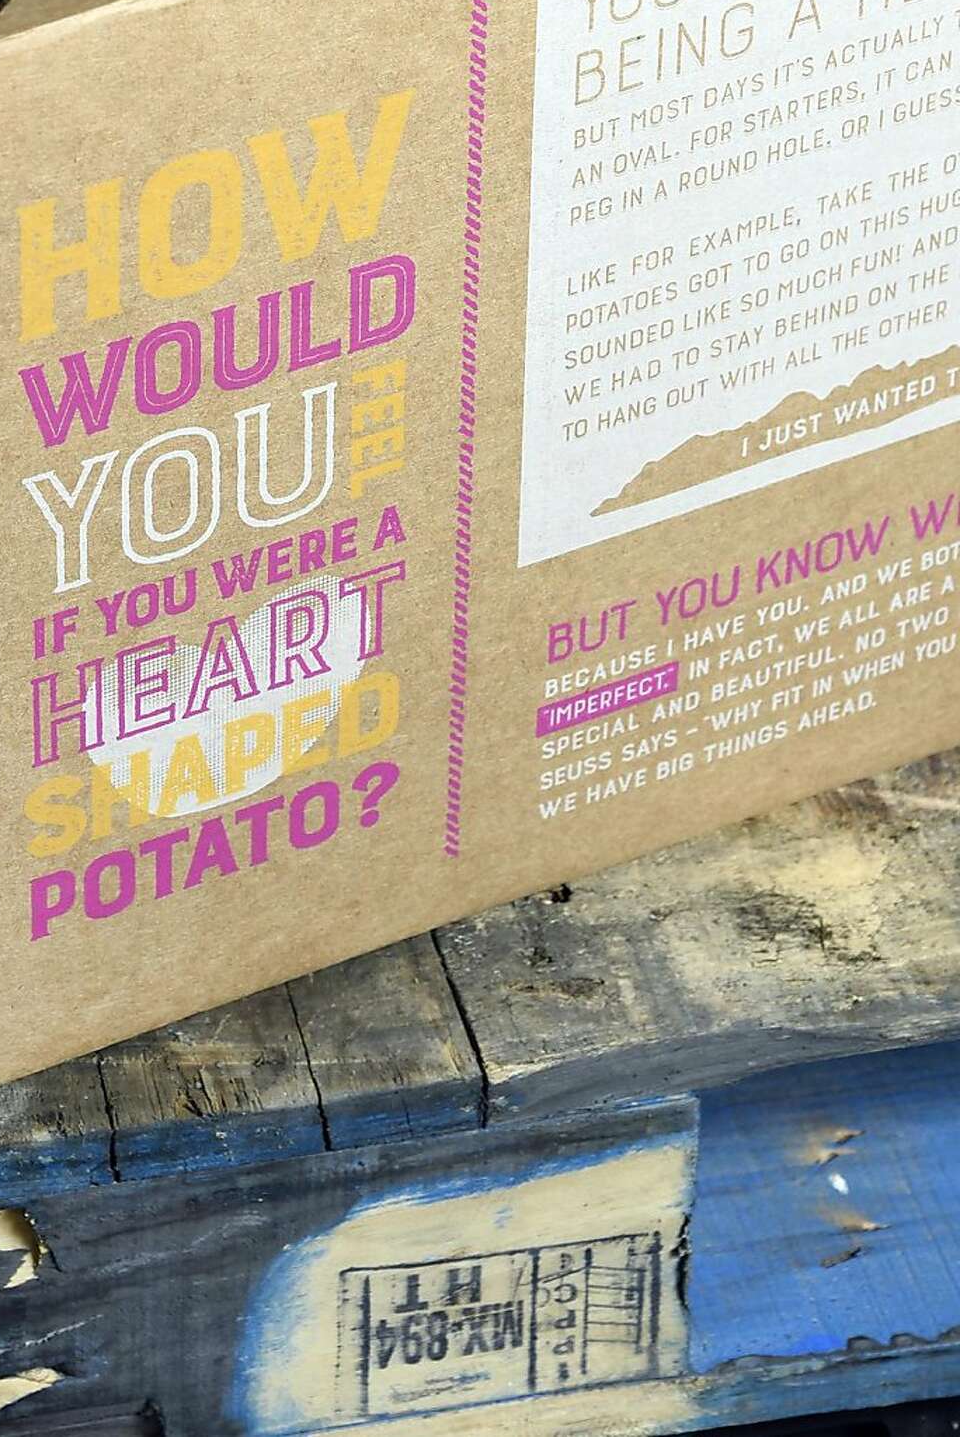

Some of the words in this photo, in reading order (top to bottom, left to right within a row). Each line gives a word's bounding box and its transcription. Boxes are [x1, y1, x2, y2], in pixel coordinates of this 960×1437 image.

[572, 161, 602, 189] AN
[613, 141, 680, 177] OVAL.
[688, 121, 732, 154] FOR
[744, 81, 865, 133] STARTERS,
[877, 68, 896, 91] IT
[906, 50, 952, 82] CAN
[574, 3, 754, 106] BEING
[574, 117, 620, 150] BUT
[631, 95, 694, 132] MOST
[704, 73, 764, 108] DAYS
[774, 57, 814, 89] IT'S
[825, 15, 944, 71] ACTUALLY
[16, 87, 417, 344] HOW
[568, 264, 617, 296] LIKE
[633, 246, 673, 275] FOR
[689, 206, 801, 259] EXAMPLE,
[817, 181, 872, 215] TAKE
[888, 163, 929, 192] THE
[570, 196, 612, 227] PEG
[623, 187, 642, 212] IN
[654, 180, 667, 202] A
[679, 150, 757, 193] ROUND
[768, 128, 831, 164] HOLE.
[842, 115, 869, 139] OR
[879, 109, 883, 131] I
[565, 319, 674, 370] SOUNDED
[683, 300, 731, 331] LIKE
[741, 288, 769, 312] SO
[778, 263, 842, 301] MUCH
[851, 244, 902, 278] FUN!
[913, 226, 958, 257] AND
[565, 378, 601, 405] WE
[612, 359, 661, 392] HAD
[672, 347, 700, 371] TO
[710, 325, 763, 359] STAY
[775, 295, 858, 337] BEHIND
[868, 281, 897, 306] ON
[908, 264, 949, 293] THE
[566, 282, 678, 334] POTATOES
[689, 263, 732, 293] GOT
[743, 252, 770, 275] TO
[780, 238, 809, 263] GO
[820, 226, 848, 251] ON
[860, 206, 909, 238] THIS
[18, 253, 416, 448] WOULD
[562, 419, 588, 442] TO
[598, 397, 656, 432] HANG
[667, 378, 709, 407] OUT
[720, 357, 775, 390] WITH
[785, 342, 822, 371] ALL
[832, 326, 869, 353] THE
[879, 300, 947, 338] OTHER
[742, 438, 748, 456] I
[759, 413, 822, 450] JUST
[834, 376, 935, 424] WANTED
[22, 381, 338, 594] YOU
[351, 359, 408, 499] FEEL
[33, 606, 80, 660] IF
[95, 568, 198, 637] YOU
[211, 517, 359, 599] WERE
[372, 505, 407, 551] A
[545, 645, 656, 698] BECAUSE
[667, 639, 673, 656] I
[684, 615, 745, 651] HAVE
[757, 596, 809, 626] YOU.
[820, 574, 866, 605] AND
[878, 558, 912, 584] WE
[547, 599, 636, 665] BUT
[656, 563, 740, 626] YOU
[756, 515, 890, 594] KNOW
[690, 658, 709, 679] IN
[719, 634, 783, 669] FACT,
[795, 617, 830, 643] WE
[839, 601, 880, 629] ALL
[890, 582, 931, 611] ARE
[941, 575, 954, 595] A
[31, 560, 406, 768] HEART
[540, 751, 611, 790] SEUSS
[622, 730, 677, 761] SAYS
[772, 685, 803, 710] FIT
[813, 675, 832, 697] IN
[843, 651, 904, 685] WHEN
[916, 633, 956, 661] YOU
[542, 713, 639, 758] SPECIAL
[652, 692, 700, 723] AND
[711, 646, 843, 701] BEAUTIFUL.
[856, 628, 885, 653] NO
[897, 607, 949, 638] TWO
[24, 671, 400, 859] SHAPED
[539, 792, 576, 818] WE
[587, 769, 646, 803] HAVE
[657, 753, 693, 779] BIG
[704, 721, 788, 762] THINGS
[798, 691, 876, 731] AHEAD.
[30, 761, 400, 941] POTATO?
